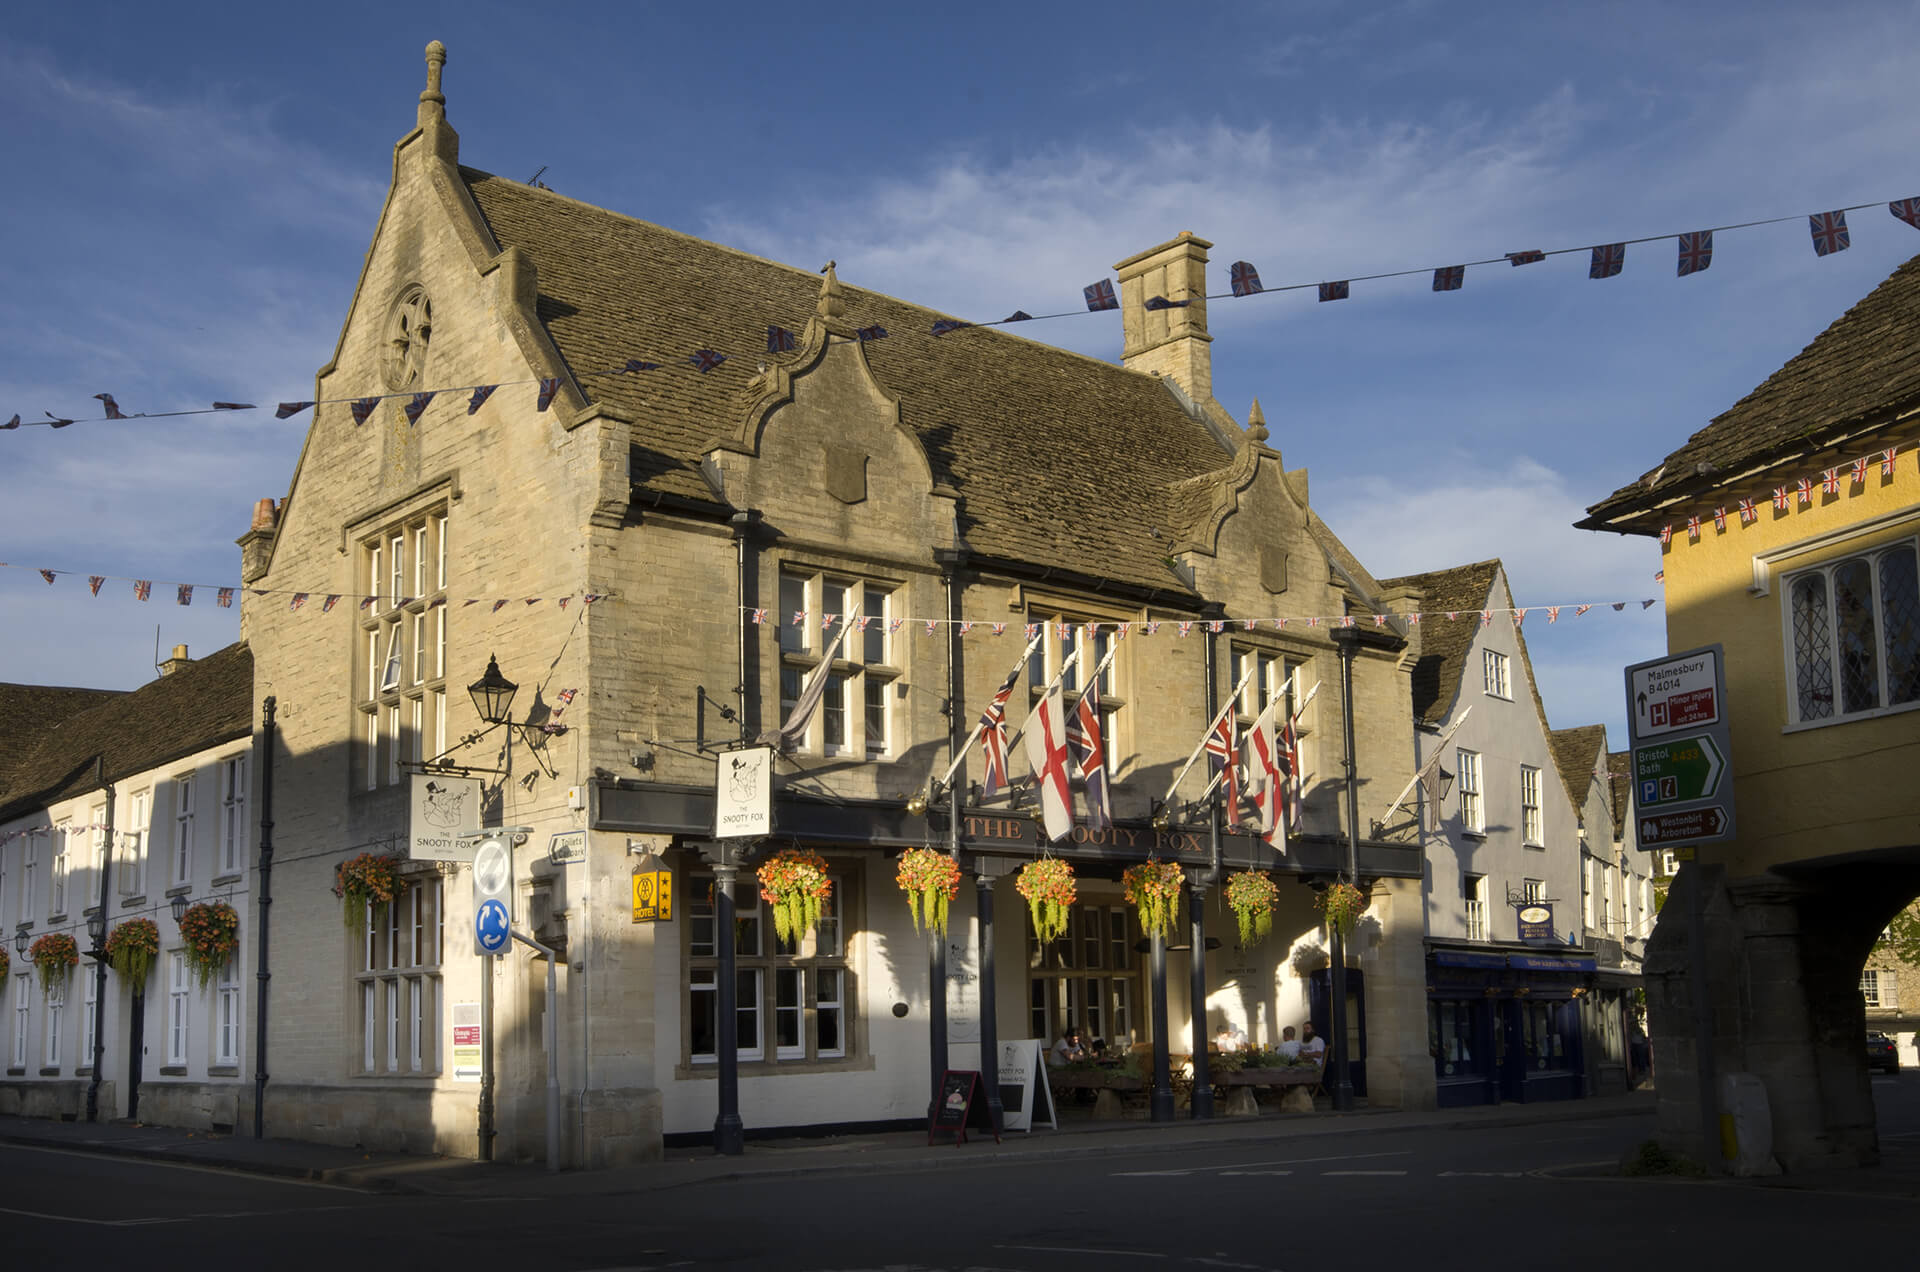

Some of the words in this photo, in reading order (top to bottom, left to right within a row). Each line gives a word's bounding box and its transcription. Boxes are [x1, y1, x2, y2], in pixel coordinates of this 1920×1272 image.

[1648, 661, 1704, 682] Malmesbury
[1649, 678, 1680, 694] B4014
[1670, 695, 1690, 705] Minor
[1684, 702, 1699, 712] unit
[1652, 704, 1666, 724] H
[1688, 713, 1698, 722] 24
[1639, 748, 1669, 762] Bristol
[1672, 749, 1699, 763] A433
[1640, 763, 1661, 775] Bath
[1644, 782, 1655, 800] P
[723, 814, 750, 824] SNOOTY
[750, 812, 764, 821] FOX
[1660, 813, 1703, 827] Westonbirt
[1710, 816, 1716, 826] 3
[964, 817, 1021, 840] THE
[1036, 824, 1140, 847] SOOTY
[1154, 831, 1202, 852] FOX
[1661, 826, 1702, 838] Arboretum
[417, 838, 453, 847] SNOOTY
[455, 840, 471, 849] FOX
[561, 837, 582, 847] Toilets
[635, 906, 657, 919] HOTEL
